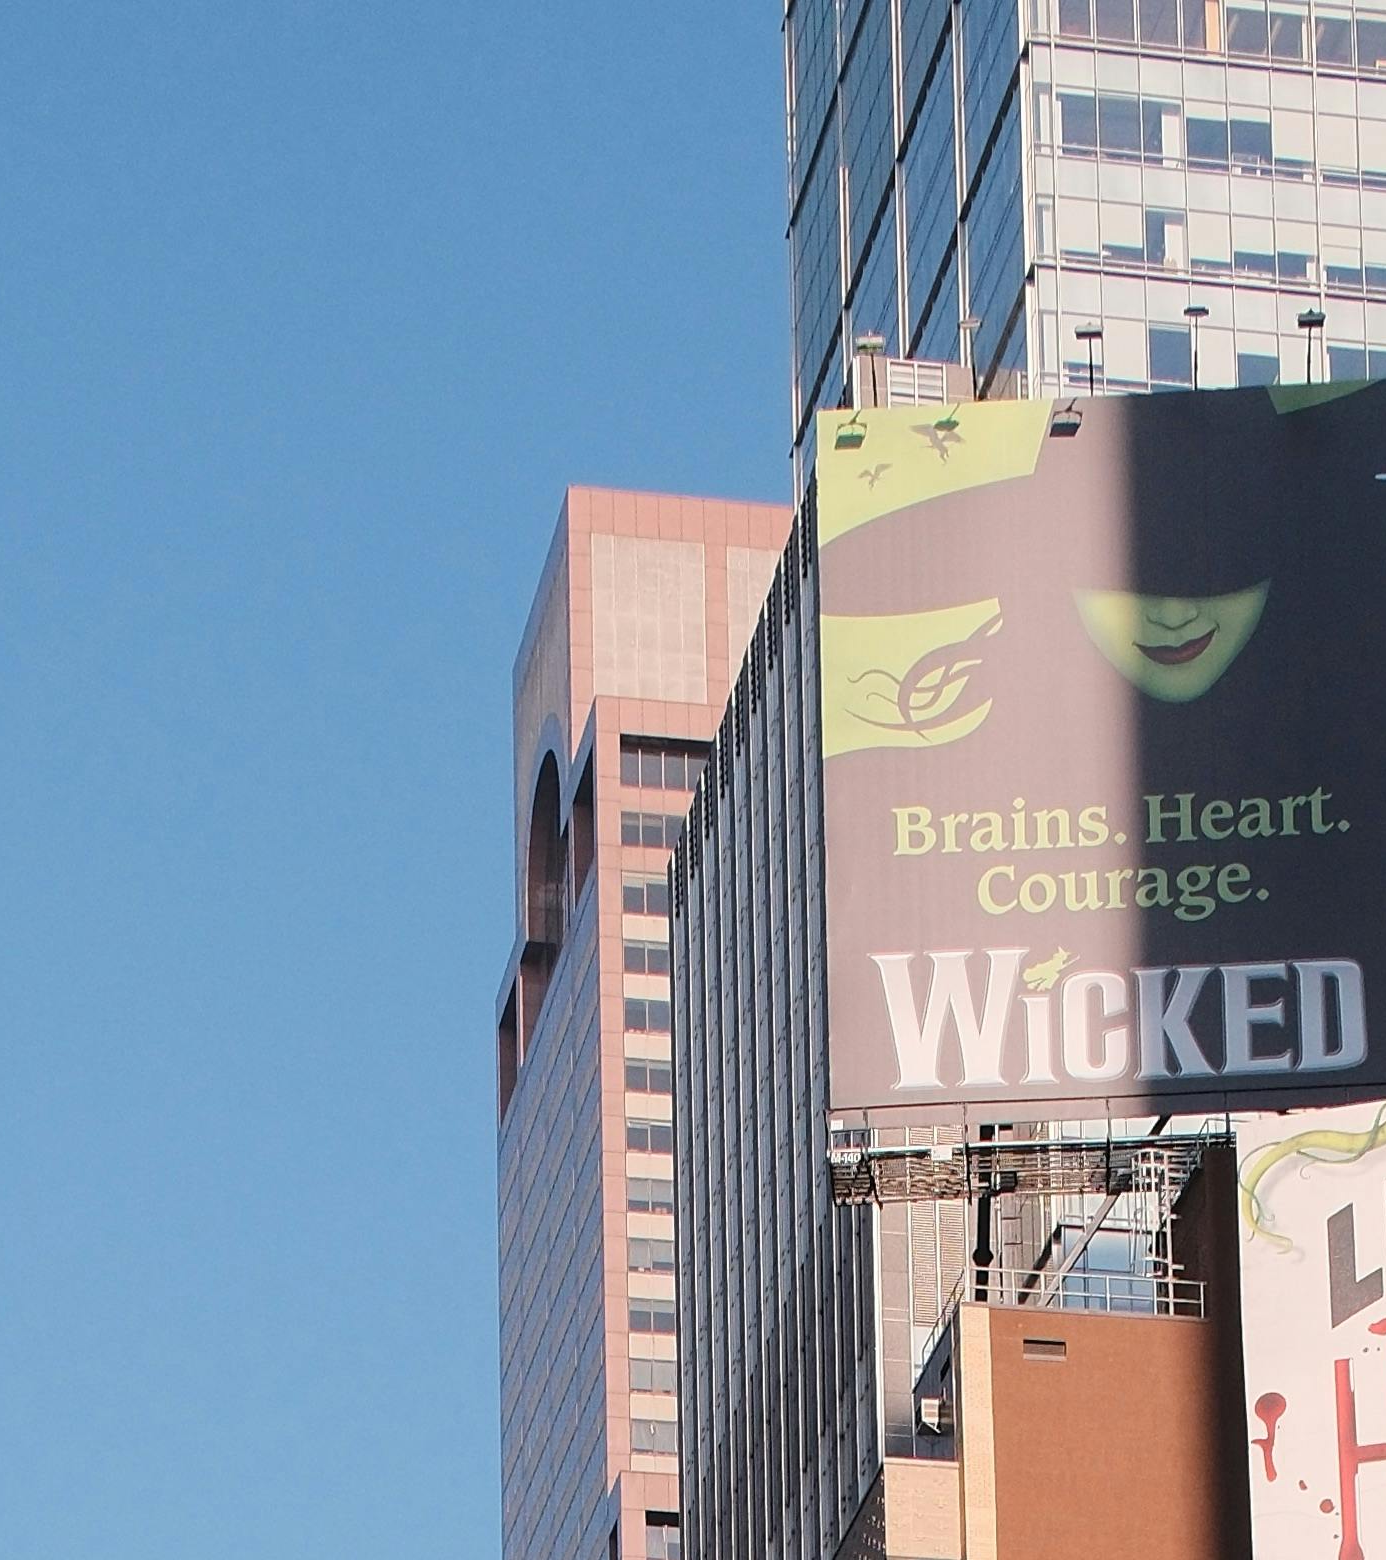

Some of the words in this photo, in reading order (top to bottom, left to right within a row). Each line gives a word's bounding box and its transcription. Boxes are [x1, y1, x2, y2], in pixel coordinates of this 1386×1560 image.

[893, 797, 1126, 857] Brains.
[1145, 787, 1351, 843] Heart.
[977, 863, 1269, 921] Courage.
[830, 1151, 862, 1164] M-140
